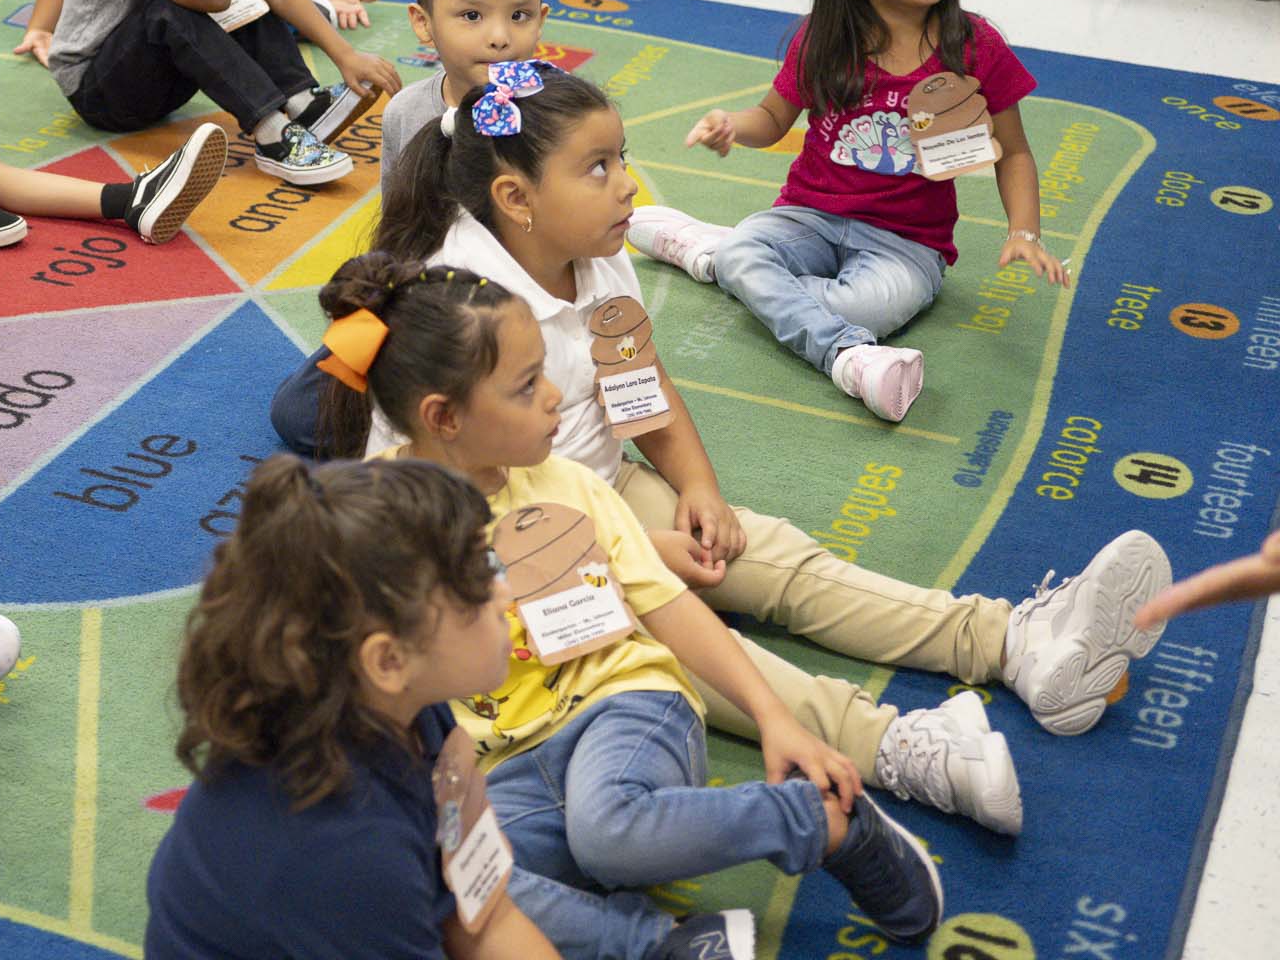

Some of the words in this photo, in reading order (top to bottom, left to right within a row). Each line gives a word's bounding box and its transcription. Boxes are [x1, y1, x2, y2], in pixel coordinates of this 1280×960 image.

[1160, 95, 1243, 131] once
[1225, 101, 1270, 116] 11
[1154, 169, 1206, 208] doce
[1217, 190, 1264, 211] 12
[30, 235, 128, 288] rojo
[1105, 280, 1163, 331] trece
[1179, 308, 1229, 332] 13
[52, 433, 198, 513] blue
[1035, 414, 1104, 502] catorce
[1123, 457, 1181, 489] 14
[1193, 440, 1272, 540] fourteen
[568, 594, 596, 608] Garcia
[1130, 641, 1219, 752] fifteen
